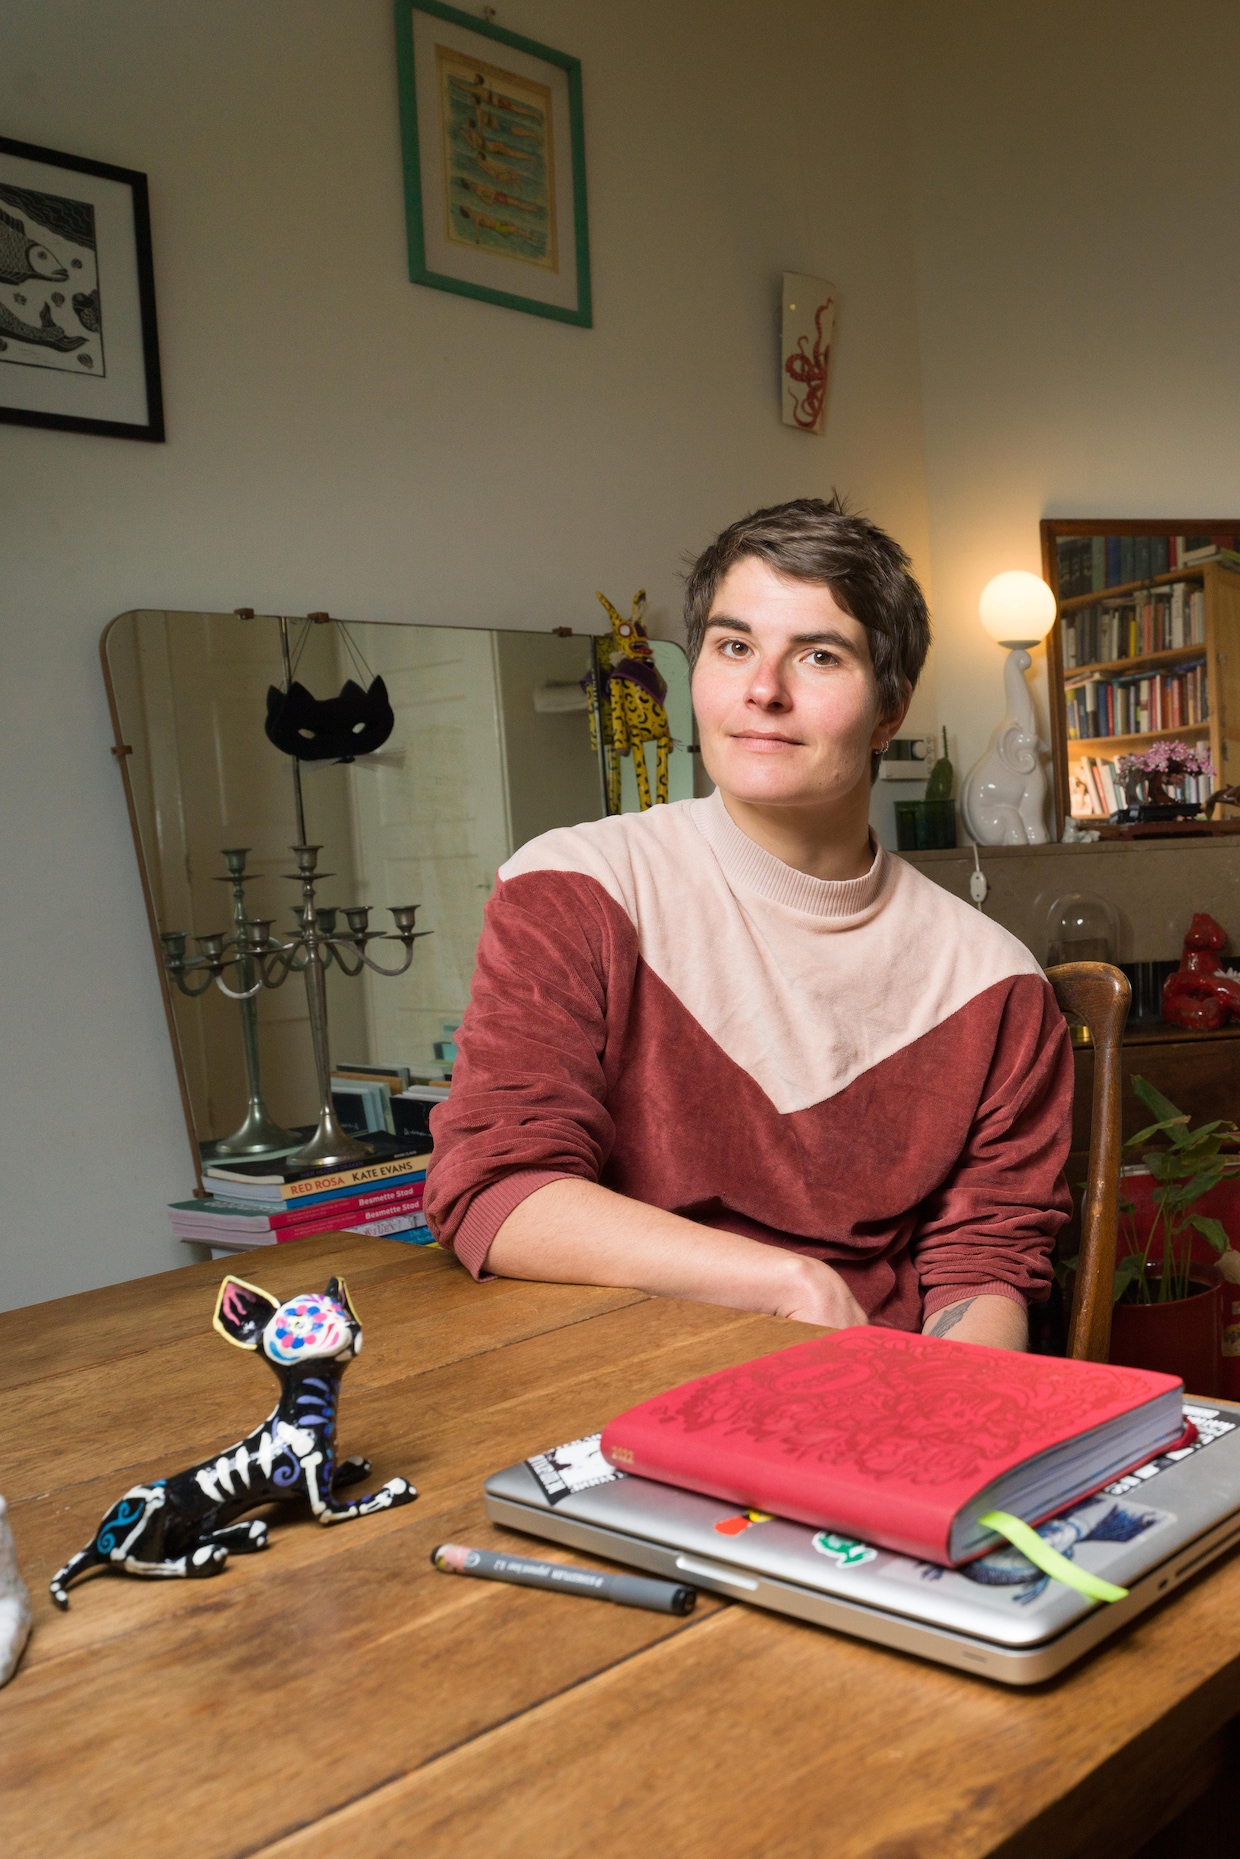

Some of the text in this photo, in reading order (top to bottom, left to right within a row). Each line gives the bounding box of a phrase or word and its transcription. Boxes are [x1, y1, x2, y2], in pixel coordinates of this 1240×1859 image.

[340, 1160, 364, 1170] DRAKEN
[290, 1162, 413, 1195] RED ROSA KATE EVANS
[358, 1187, 414, 1206] Besmette Stad
[365, 1201, 420, 1220] Besmette Stad
[611, 1446, 634, 1464] 2022
